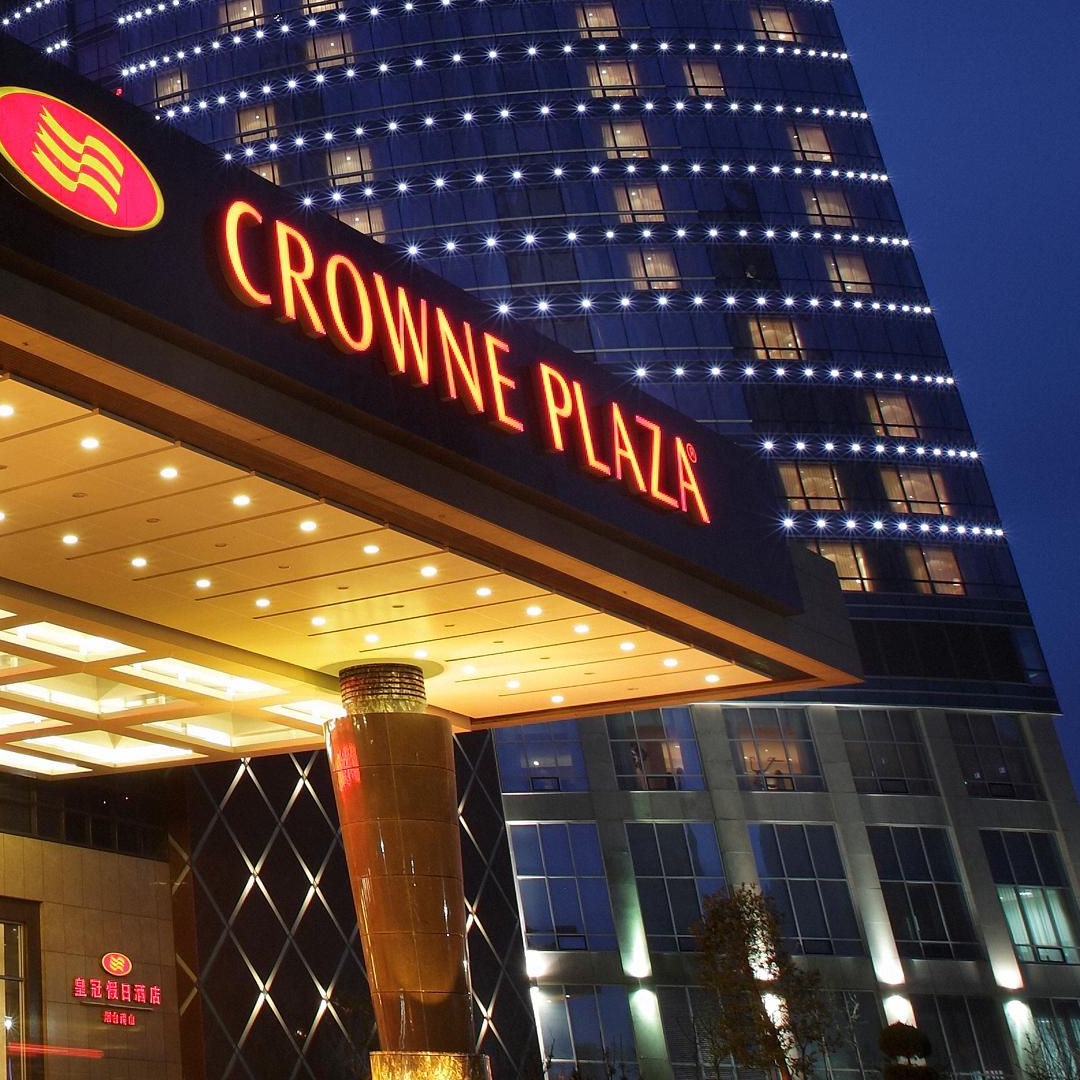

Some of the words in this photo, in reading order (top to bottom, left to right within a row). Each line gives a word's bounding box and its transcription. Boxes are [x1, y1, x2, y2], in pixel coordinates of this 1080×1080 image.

[223, 200, 525, 432] CROWNE
[74, 977, 161, 1005] 皇冠假日酒店
